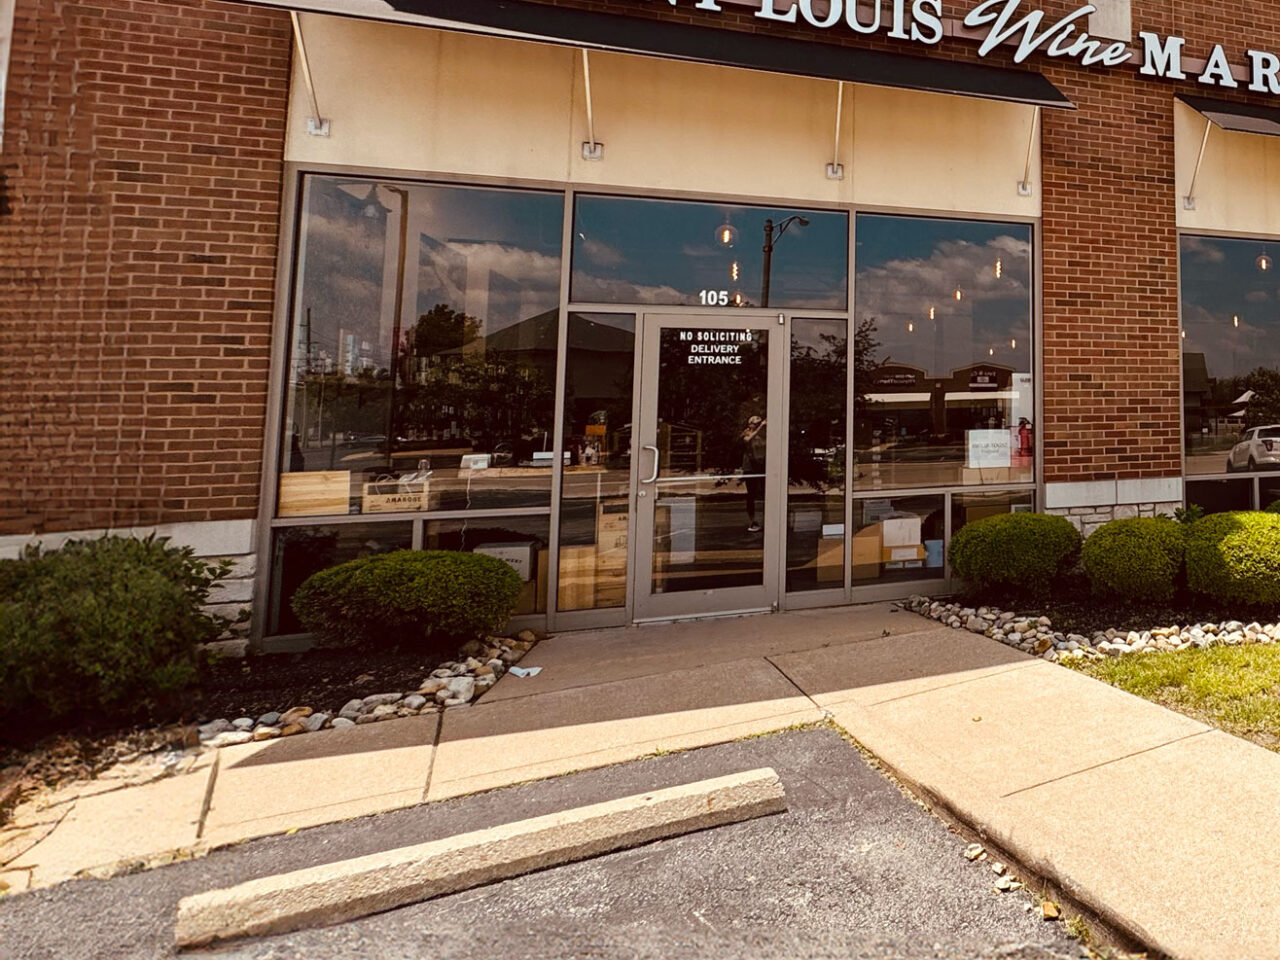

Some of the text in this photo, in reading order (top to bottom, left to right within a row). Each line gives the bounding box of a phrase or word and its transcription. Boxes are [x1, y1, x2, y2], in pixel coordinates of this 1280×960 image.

[699, 290, 729, 306] 105
[680, 331, 752, 342] NO SOLICITING
[690, 344, 740, 354] DELIVERY
[687, 355, 742, 365] ENTRANCE
